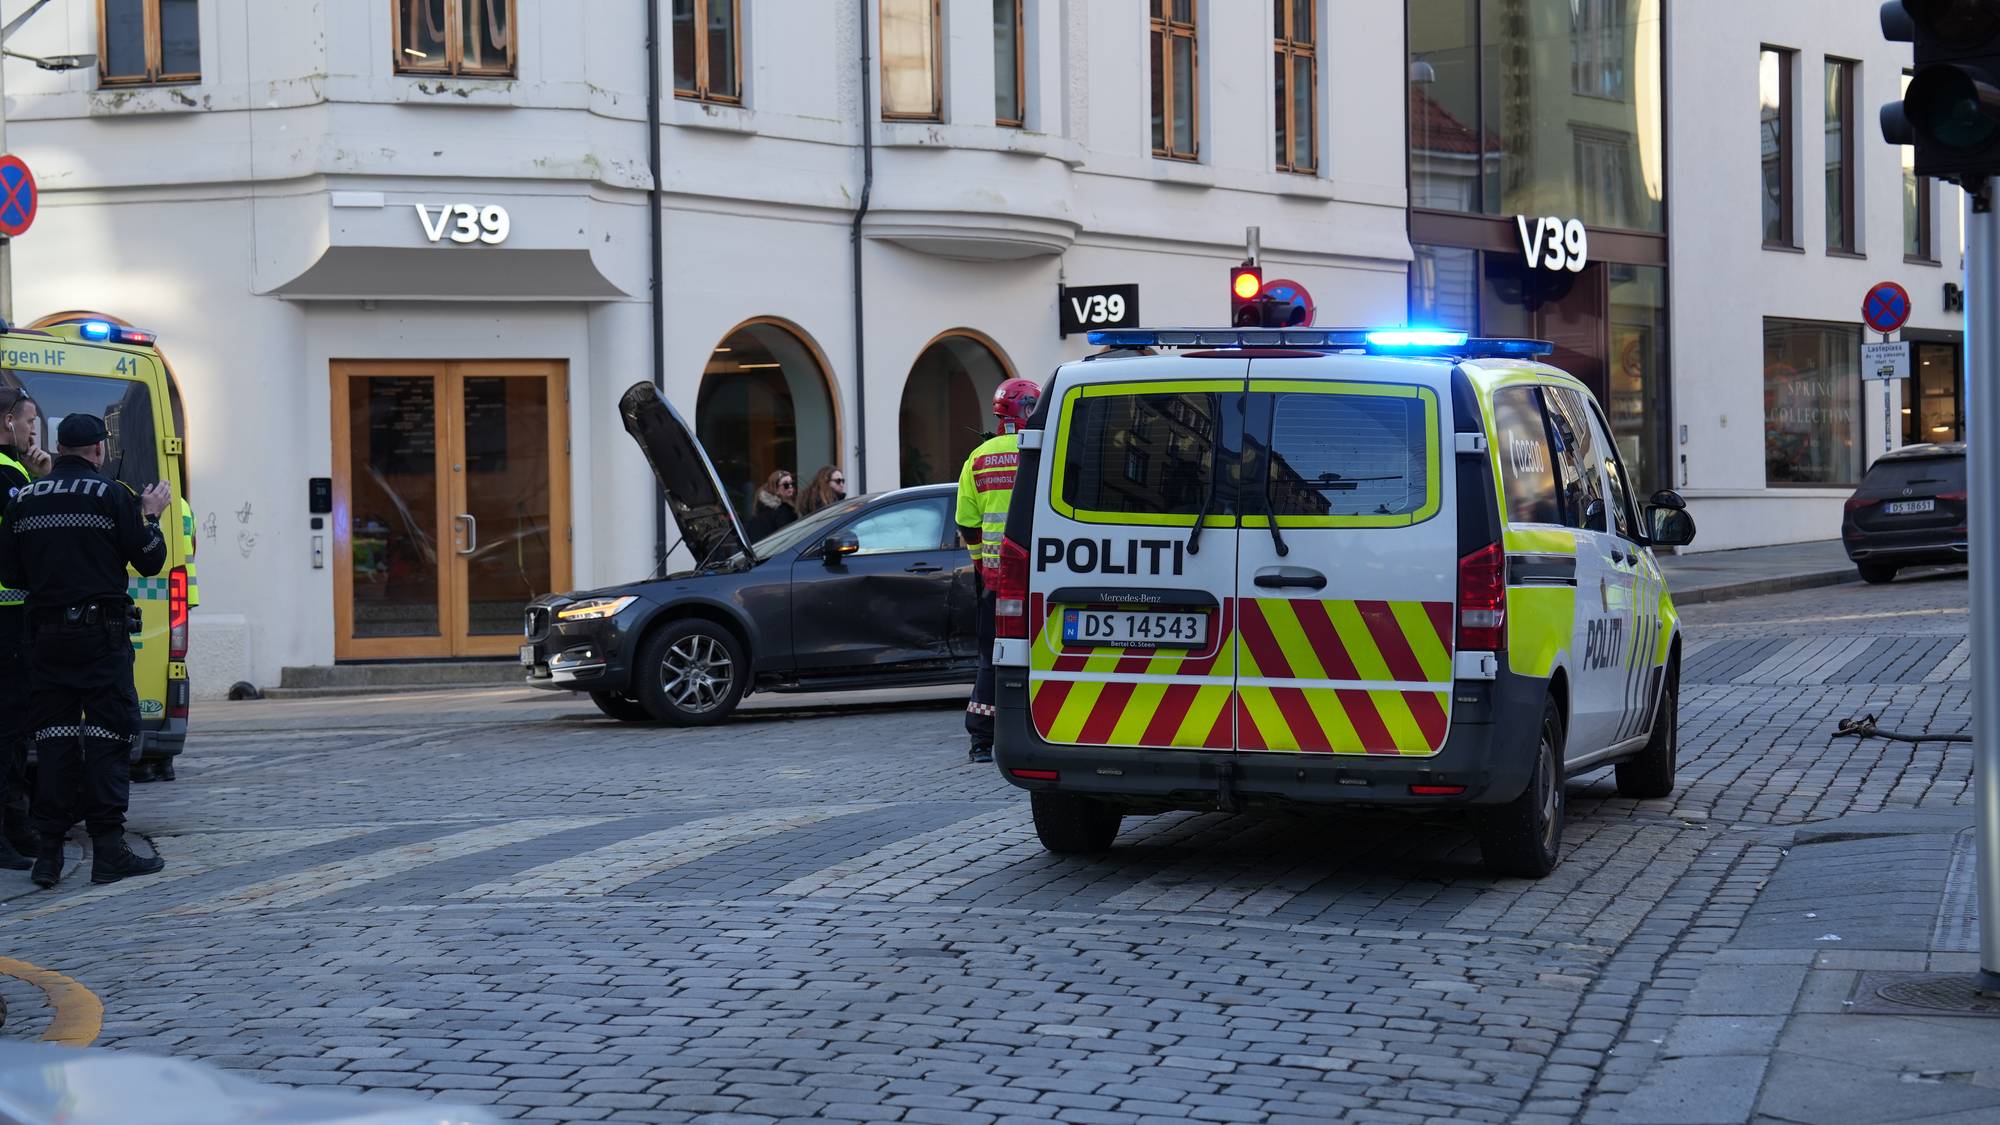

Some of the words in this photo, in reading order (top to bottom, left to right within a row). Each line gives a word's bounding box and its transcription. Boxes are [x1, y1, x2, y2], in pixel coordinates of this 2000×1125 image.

[415, 203, 510, 244] V39
[1517, 214, 1588, 273] V39
[1072, 294, 1126, 324] V39
[45, 350, 66, 366] HF
[115, 357, 137, 376] 41
[1788, 381, 1834, 397] SPRING
[1770, 407, 1850, 423] COLLECTION
[985, 454, 1018, 466] BRANN
[1515, 439, 1544, 472] 02800
[17, 478, 107, 503] POLITI
[1892, 503, 1904, 512] DS
[1036, 537, 1184, 576] POLITI
[1100, 593, 1161, 603] Mercedes-Benz
[1067, 628, 1075, 636] N
[1085, 614, 1115, 638] DS
[1126, 615, 1197, 640] 14543
[1583, 618, 1622, 671] POLITI
